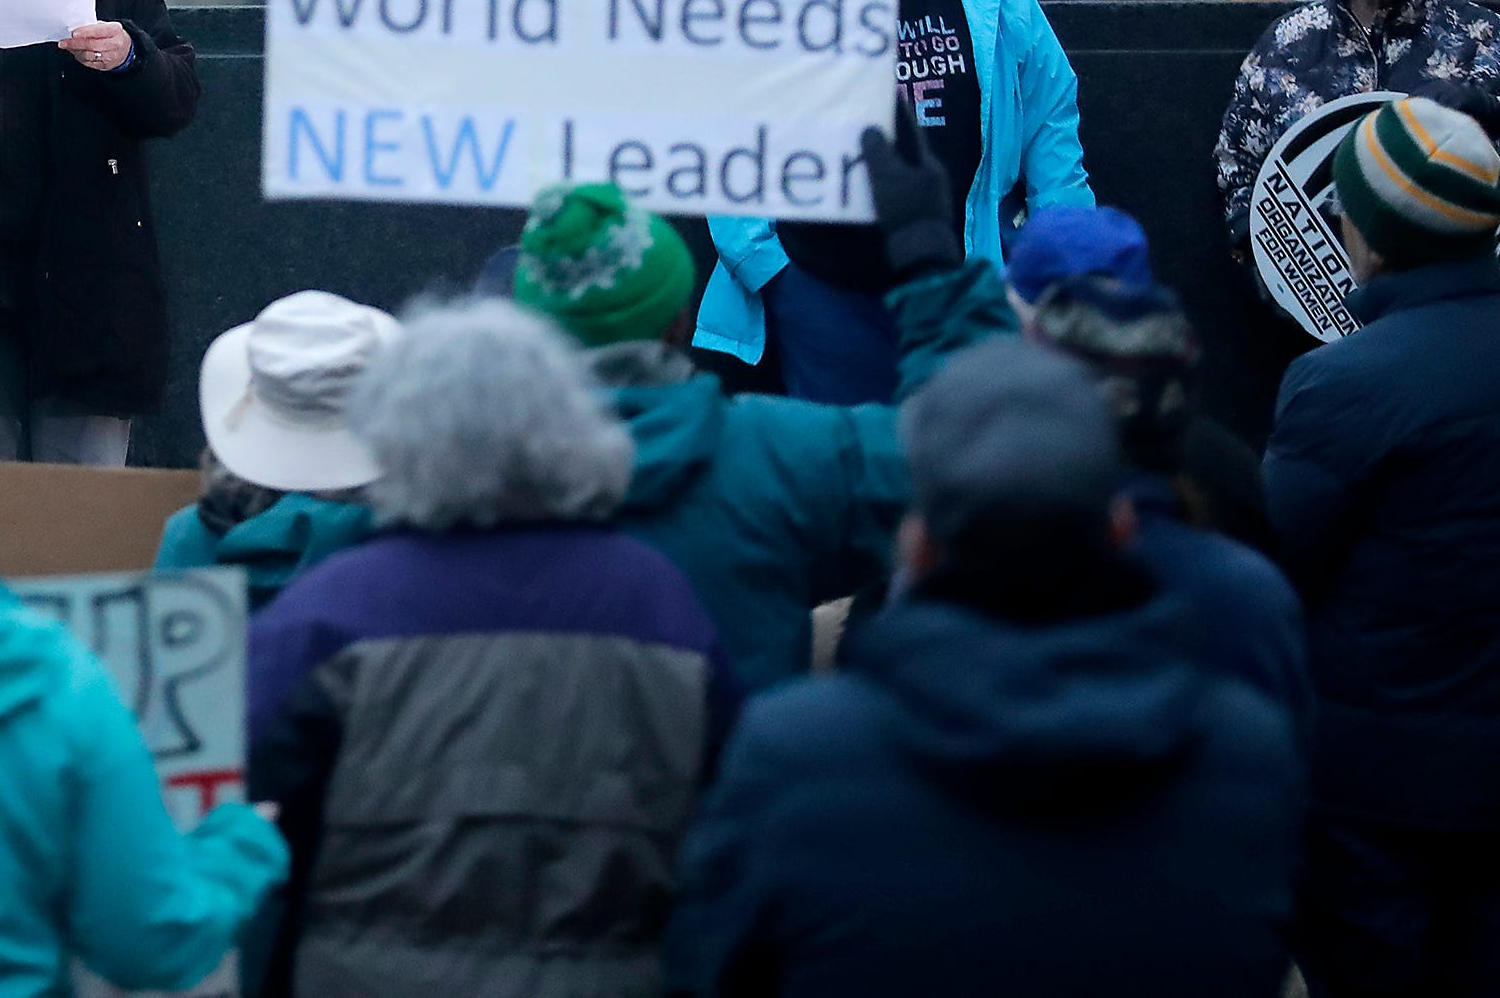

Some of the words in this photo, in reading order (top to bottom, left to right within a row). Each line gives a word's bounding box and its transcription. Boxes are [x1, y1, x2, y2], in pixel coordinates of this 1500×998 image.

[896, 53, 966, 81] OUGH
[931, 35, 961, 53] GO
[286, 108, 517, 192] NEW
[1258, 196, 1361, 337] ORGANIZATION
[1258, 226, 1288, 264] FOR
[1283, 257, 1333, 332] WOMEN
[1266, 171, 1358, 298] NATION
